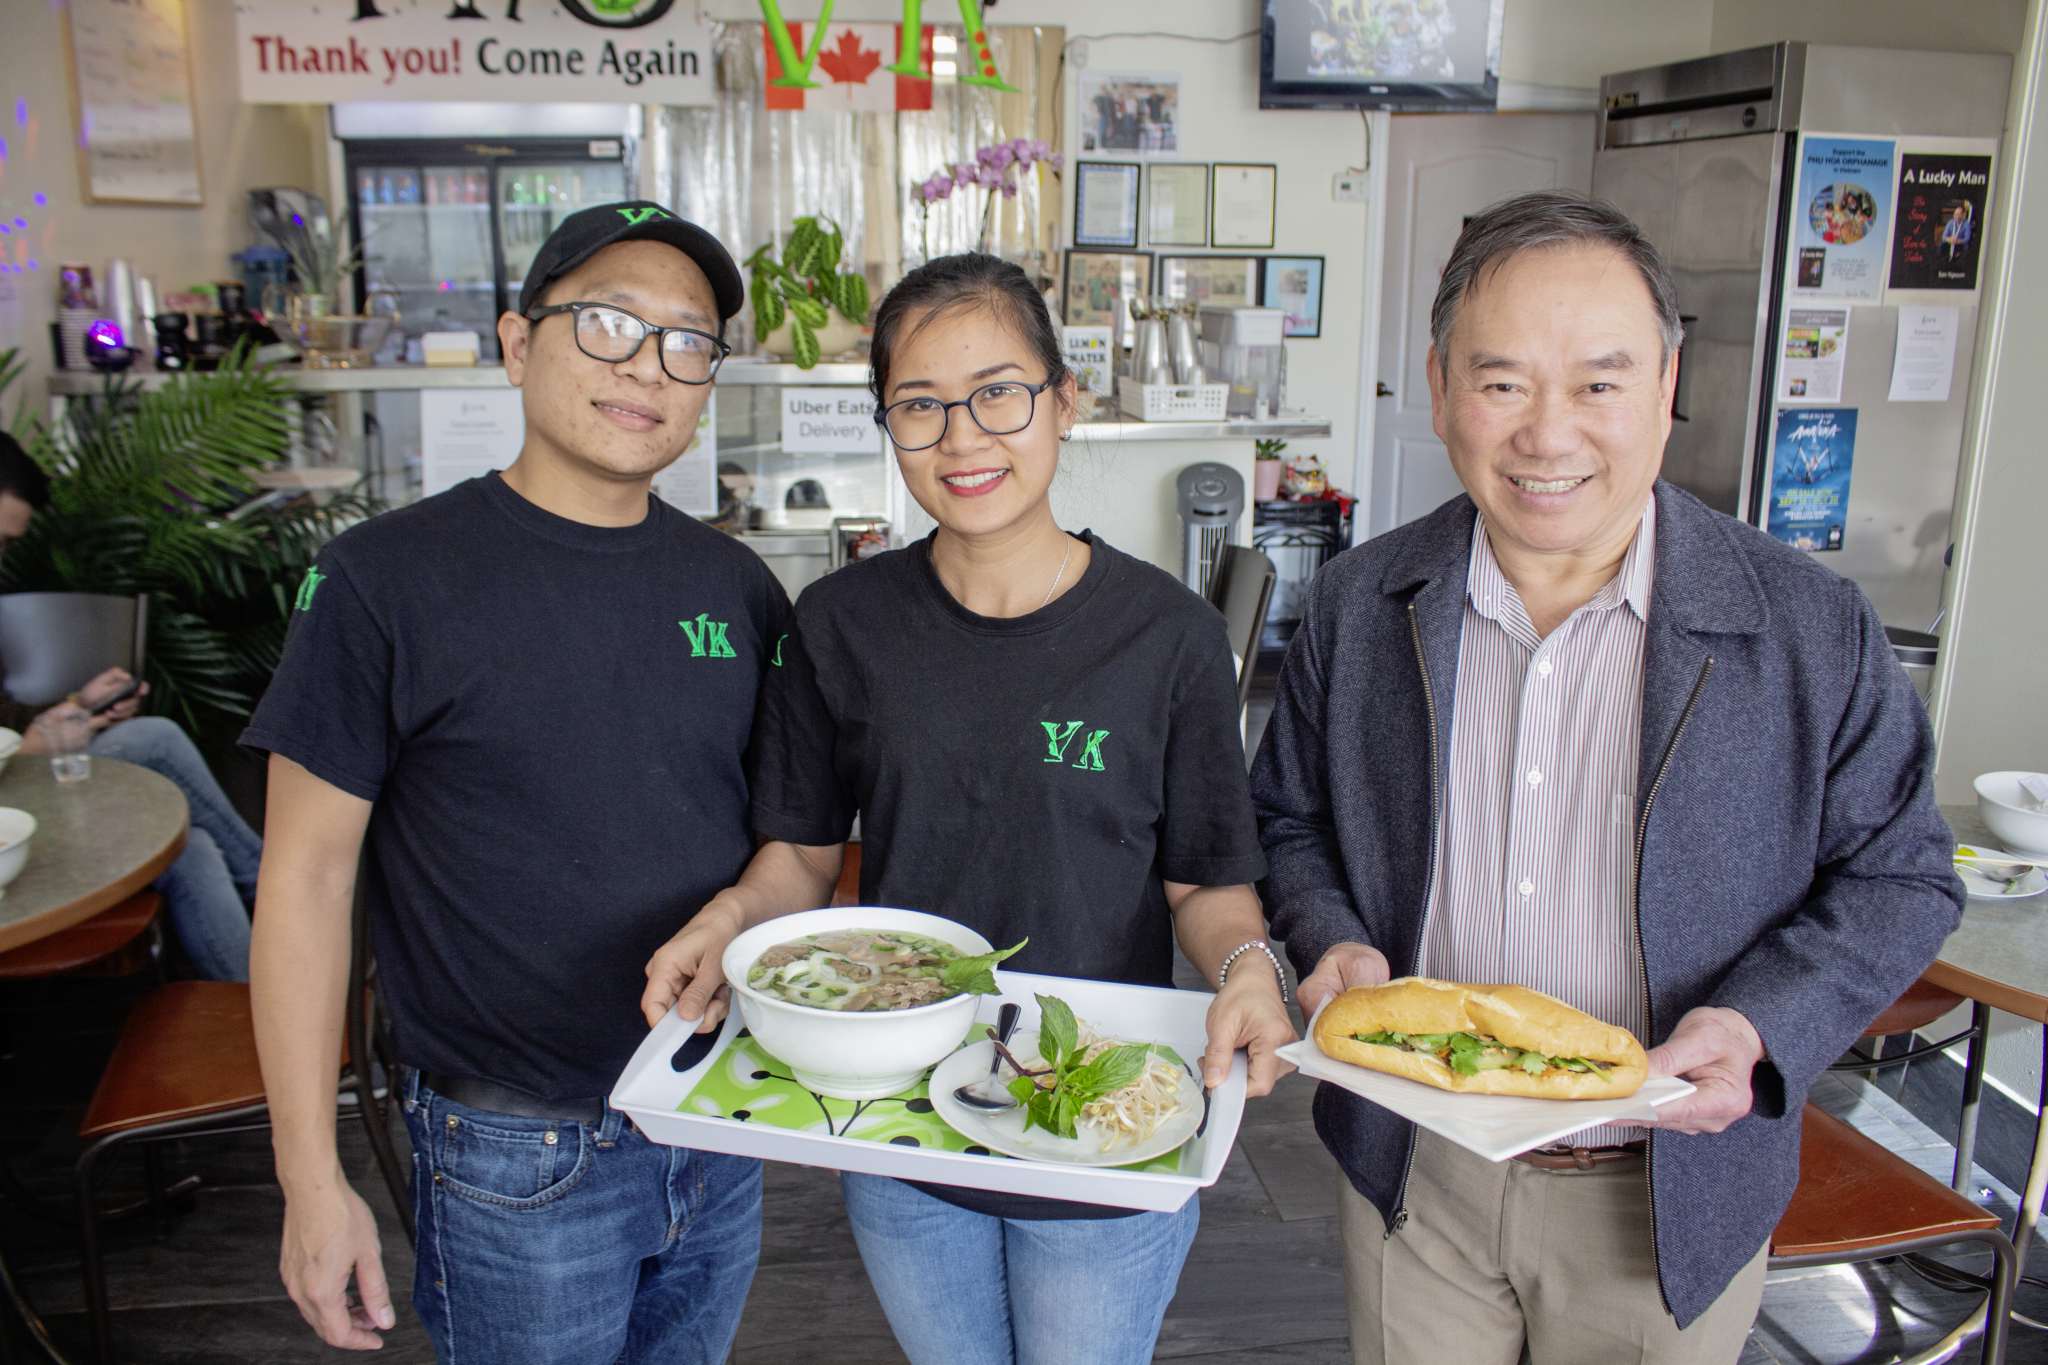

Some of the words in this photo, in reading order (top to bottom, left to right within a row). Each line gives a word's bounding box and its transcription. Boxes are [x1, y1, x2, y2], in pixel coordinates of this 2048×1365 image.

[251, 35, 370, 74] Thank
[383, 37, 462, 84] you!
[477, 38, 584, 75] Come
[600, 39, 699, 85] Again
[1903, 168, 1915, 183] A
[1918, 169, 1956, 187] Lucky
[1958, 171, 1986, 185] Man
[1070, 338, 1106, 348] LEMON
[789, 399, 832, 414] Uber
[837, 400, 874, 415] Eats
[799, 421, 865, 442] Delivery
